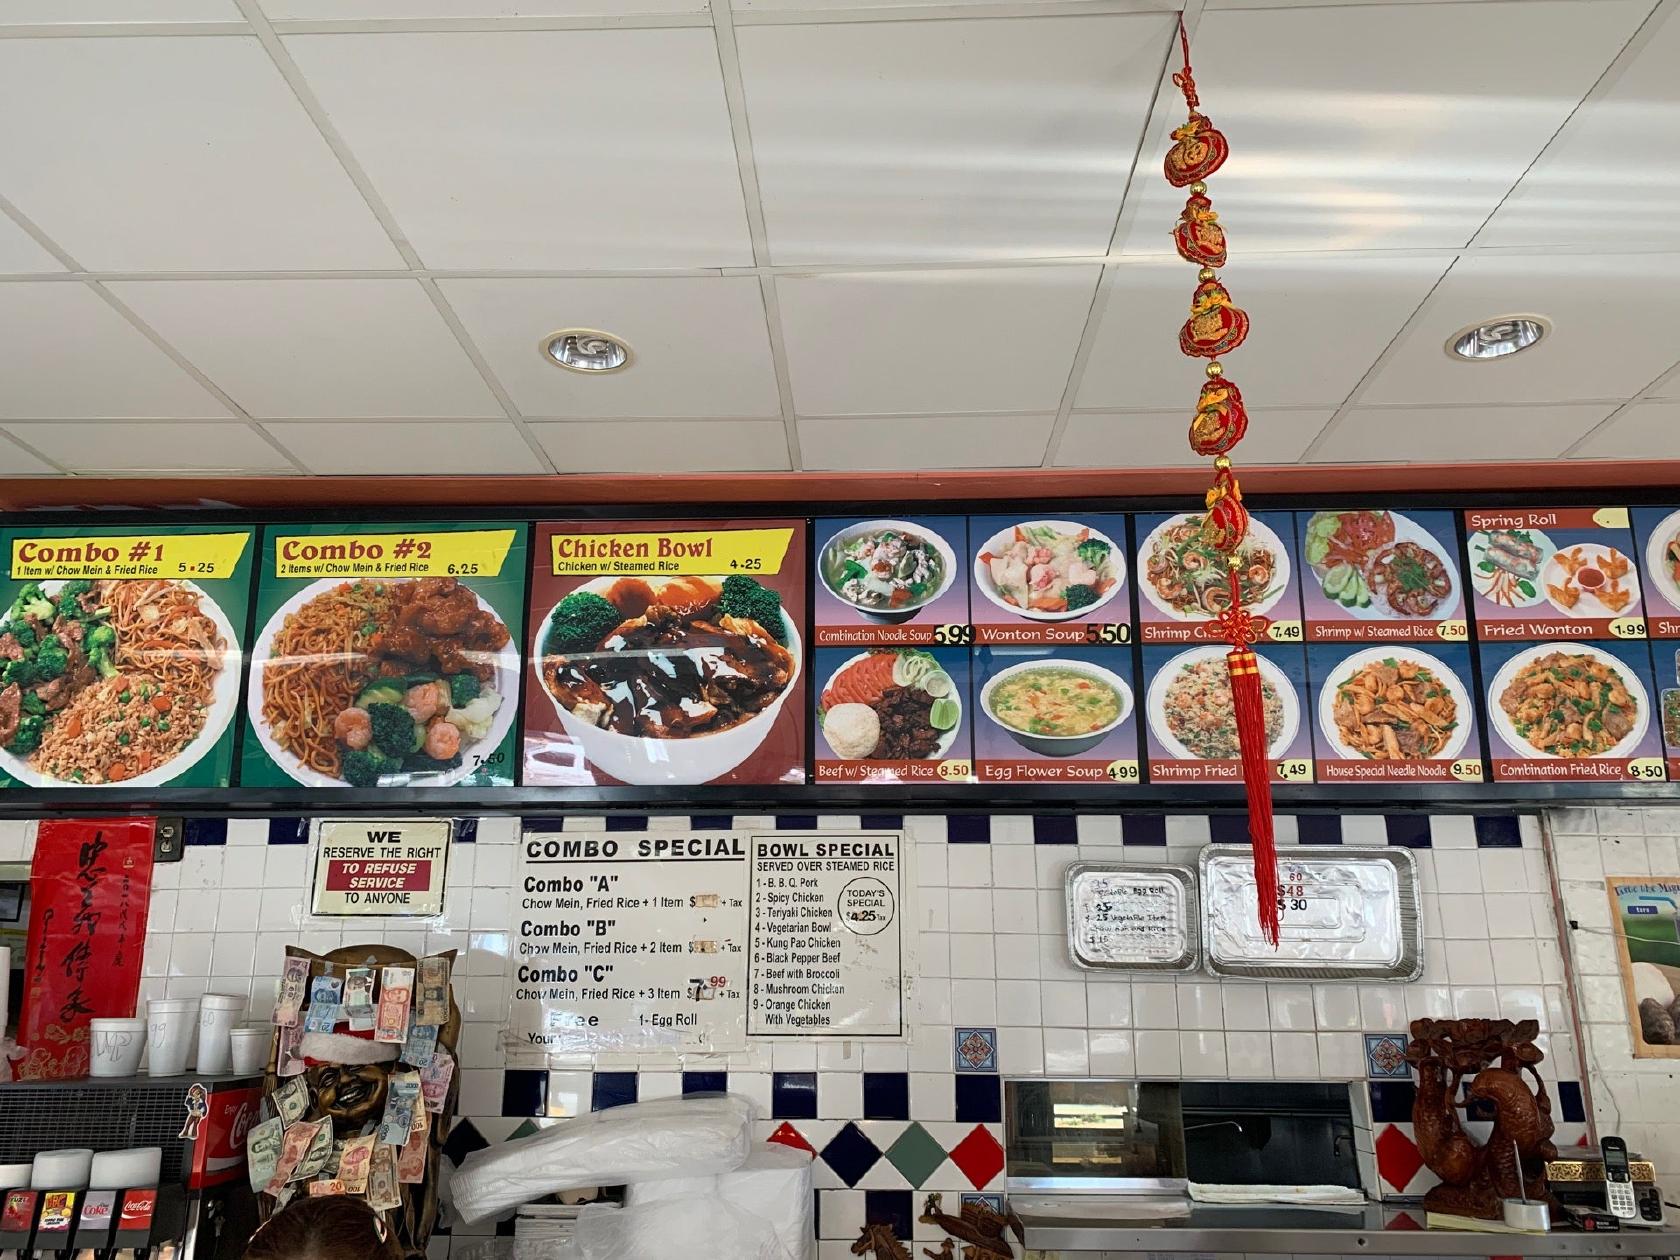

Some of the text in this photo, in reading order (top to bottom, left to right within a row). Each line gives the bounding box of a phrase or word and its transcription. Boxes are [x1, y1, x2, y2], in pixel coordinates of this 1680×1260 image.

[1471, 514, 1557, 528] Spring Roll
[19, 541, 164, 563] Combo #1
[282, 538, 432, 561] Combo #2
[558, 537, 713, 558] Chicken Bowl
[16, 564, 158, 575] 1 Item w/ Chow Mein & Fried Rice
[281, 563, 429, 574] 2 Items w/ Chow Mein & Fried Rice
[448, 563, 478, 574] 6.25
[558, 561, 679, 571] Chicken w/ Steamed Rice
[819, 629, 932, 643] Combination Noodle Soup
[982, 628, 1085, 643] Wonton Soup
[1145, 627, 1191, 640] Shrimp
[1315, 625, 1433, 639] Shrimp w/ Steamed Rice
[1439, 625, 1466, 636] 7.50
[1484, 624, 1593, 636] Fried Wonton
[1615, 624, 1645, 635] 1.99
[819, 765, 843, 778] Beef
[845, 766, 858, 777] w/
[911, 765, 934, 776] Rice
[940, 765, 968, 776] 8.50
[986, 765, 1103, 779] Egg Flower Soup
[1153, 765, 1200, 780] Shrimp
[1204, 764, 1238, 777] Fried
[1326, 765, 1353, 777] House
[1355, 765, 1385, 778] Special
[1453, 764, 1481, 776] 9.50
[1500, 764, 1621, 776] Combination Fried Rice
[1631, 765, 1663, 777] 8.50
[367, 831, 402, 843] WE
[323, 847, 441, 858] RESERVE THE RIGHT
[526, 839, 745, 858] COMBO SPECIAL
[757, 843, 894, 857] BOWL SPECIAL
[342, 863, 417, 874] TO REFUSE
[757, 862, 894, 872] SERVED OVER STEAMED RICE
[349, 878, 405, 888] SERVICE
[524, 875, 619, 893] Combo "A"
[800, 878, 818, 887] Pork
[345, 892, 410, 904] TO ANYONE
[522, 898, 552, 909] Chow
[586, 897, 613, 908] Fried
[616, 897, 640, 908] Rice
[653, 897, 657, 907] 1
[661, 897, 683, 908] Item
[729, 898, 743, 907] Tax
[768, 892, 824, 905] Spicy Chicken
[767, 907, 833, 920] Teriyaki Chicken
[520, 920, 616, 936] Combo "B"
[767, 922, 831, 935] Vegetarian Bowl
[519, 942, 550, 954] Chow
[583, 942, 612, 954] Fried
[615, 942, 638, 953] Rice
[650, 942, 656, 953] 2
[659, 942, 682, 953] Item
[728, 943, 742, 952] Tax
[766, 937, 840, 950] Kung Pao Chicken
[766, 952, 841, 966] Black Pepper Beef
[517, 965, 614, 983] Combo "C"
[766, 968, 840, 978] Beef with Broccoli
[582, 988, 609, 1000] Fried
[612, 988, 635, 999] Rice
[648, 988, 654, 999] 3
[658, 988, 680, 999] Item
[726, 989, 740, 999] Tax
[766, 984, 844, 994] Mushroom Chicken
[766, 999, 831, 1012] Orange Chicken
[652, 1015, 673, 1027] Egg
[676, 1014, 697, 1026] Roll
[765, 1014, 830, 1027] With Vegetables
